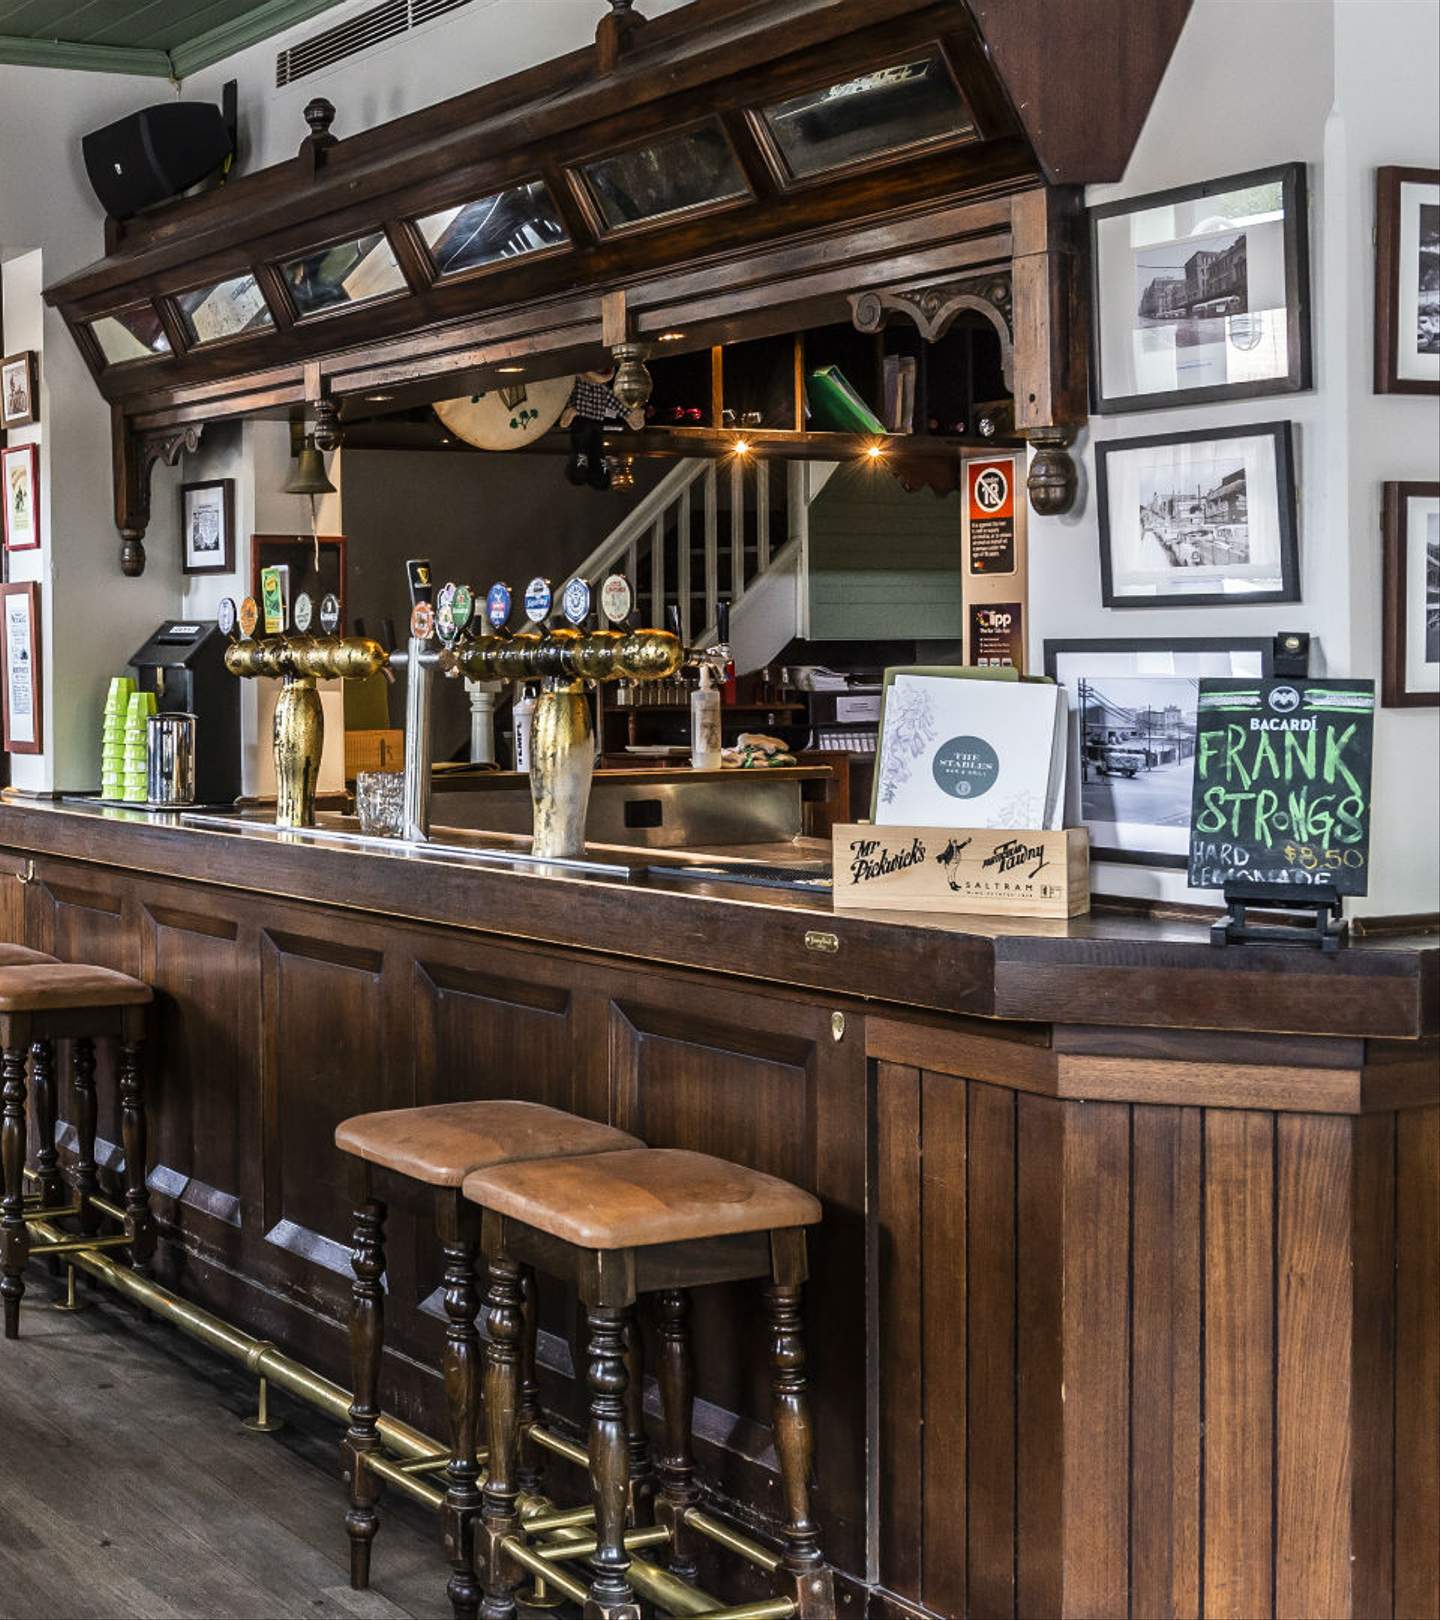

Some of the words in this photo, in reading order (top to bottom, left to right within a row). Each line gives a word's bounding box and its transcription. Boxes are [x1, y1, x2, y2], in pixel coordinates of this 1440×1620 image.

[1250, 715, 1318, 731] BACARDÍ
[940, 760, 993, 769] STABLES
[954, 752, 980, 760] THE
[1199, 722, 1362, 797] FRANK
[850, 838, 926, 885] Pickwick's
[994, 840, 1050, 879] Tawny
[1192, 840, 1250, 867] HARD
[965, 881, 1033, 891] SALTRAM
